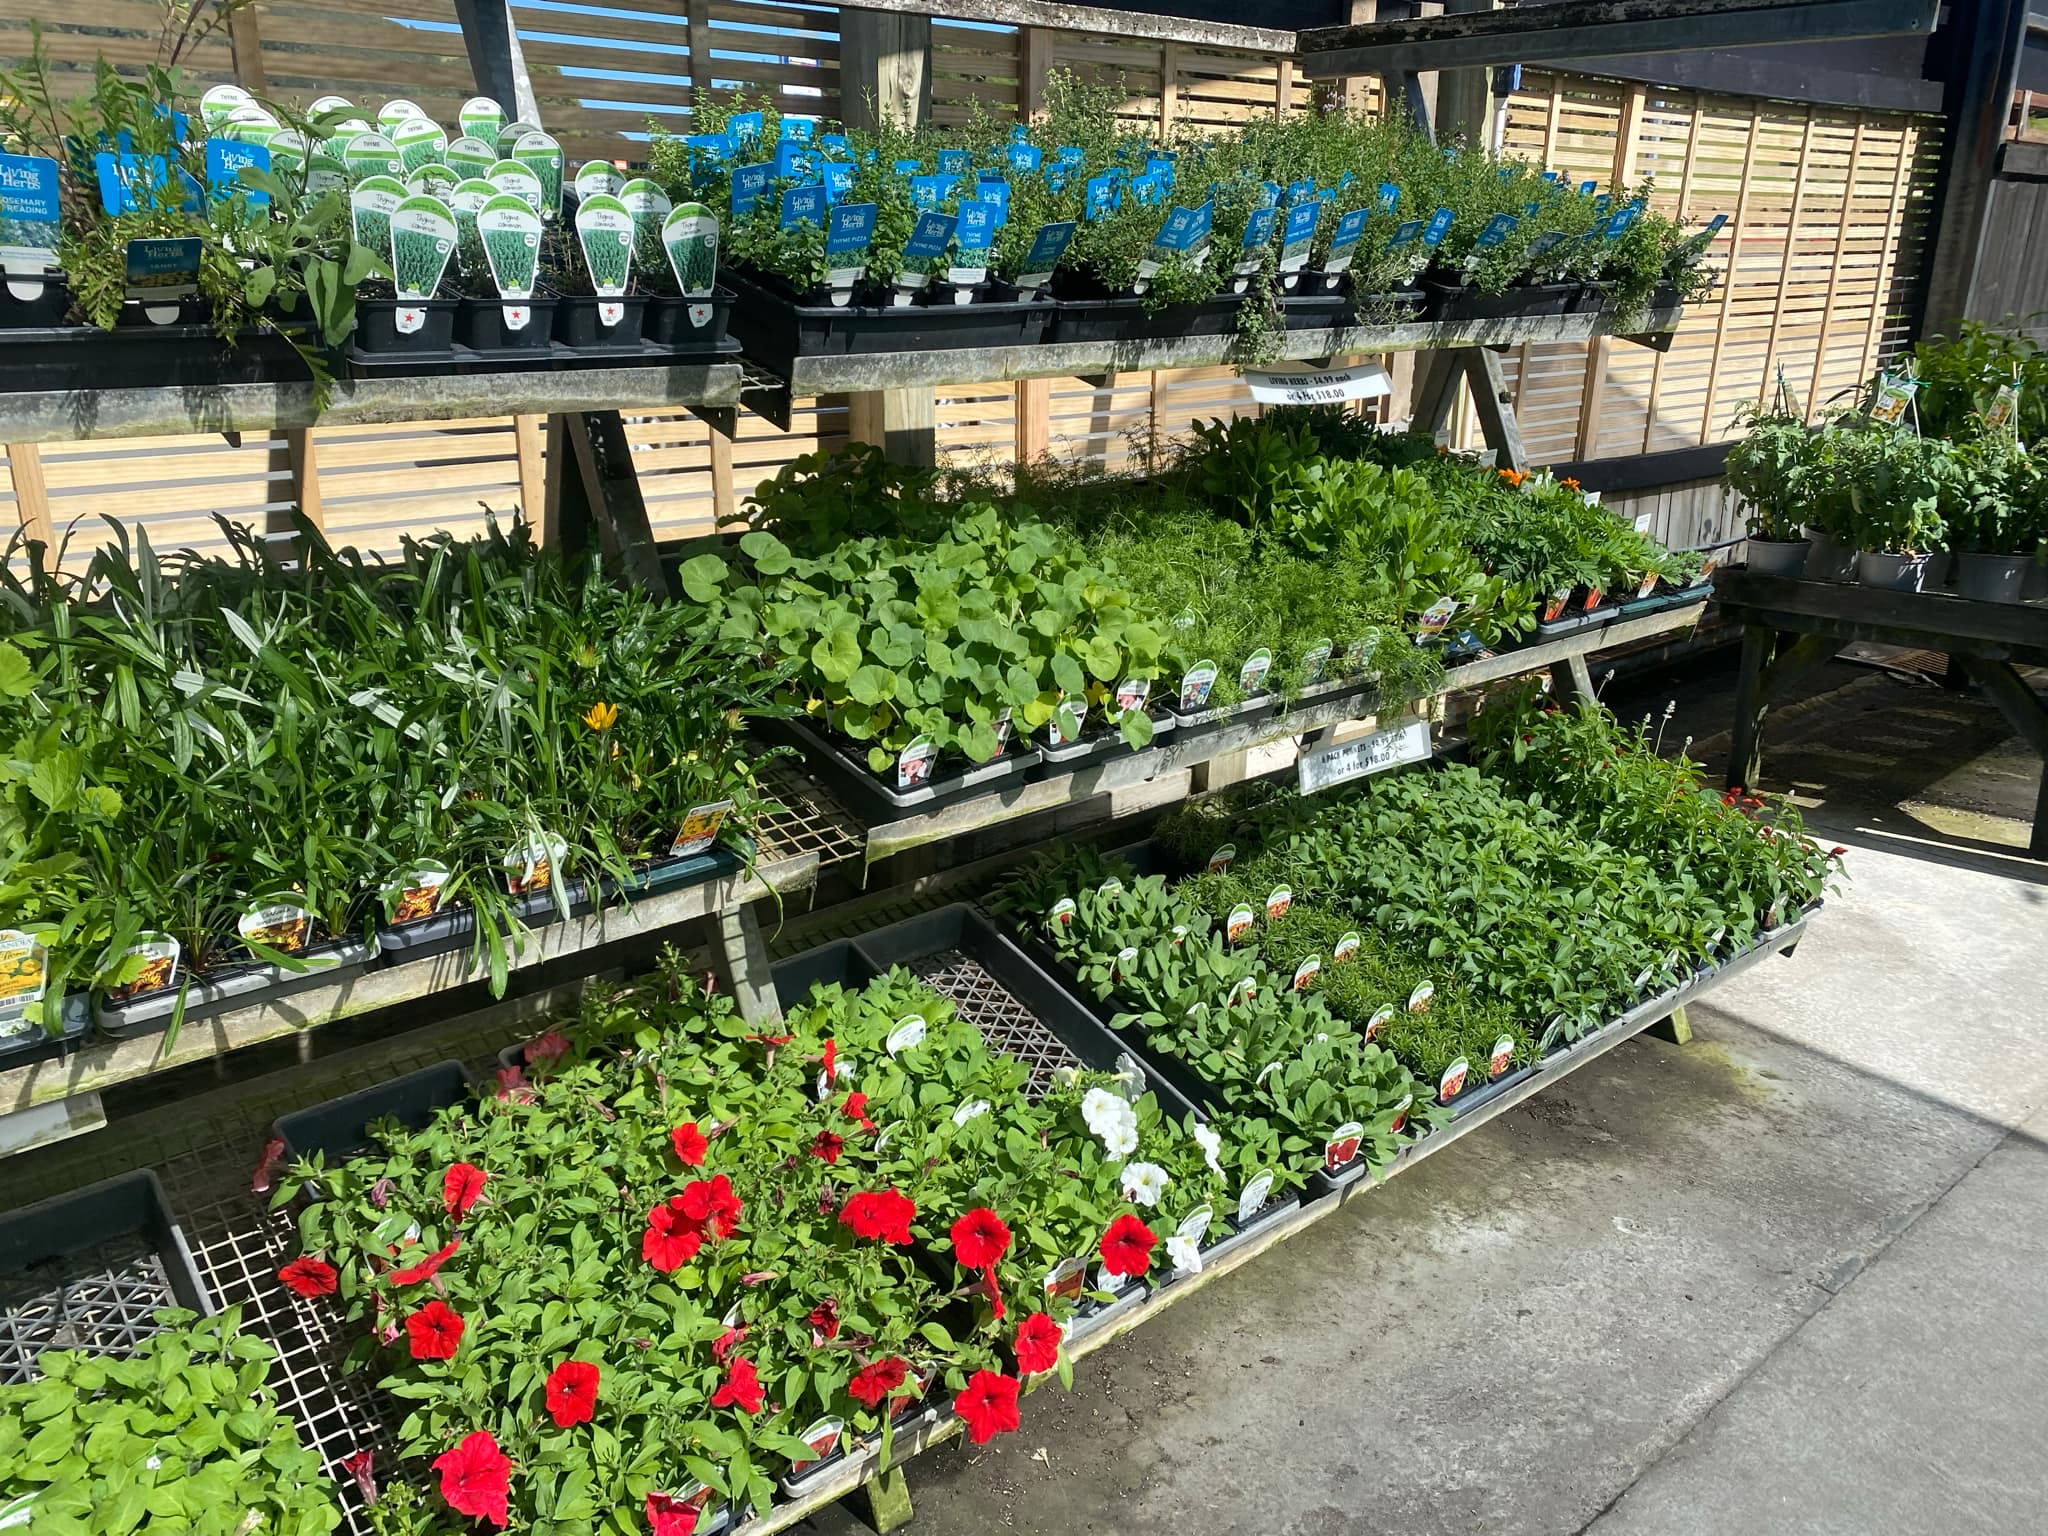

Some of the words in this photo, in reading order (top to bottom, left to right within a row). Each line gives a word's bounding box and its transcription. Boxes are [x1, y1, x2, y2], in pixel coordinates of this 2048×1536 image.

[220, 149, 254, 167] Living
[3, 172, 41, 190] Herbs
[0, 196, 47, 207] OSEMARY
[375, 194, 396, 205] Thyme
[416, 213, 436, 225] Thyme
[499, 212, 519, 223] Thyme
[596, 212, 614, 222] Thyme
[842, 214, 865, 223] Living
[411, 223, 437, 233] common
[1268, 376, 1288, 386] LIVING
[1288, 377, 1309, 386] HERBS
[1313, 376, 1334, 385] $4.99
[1335, 372, 1352, 383] each
[1315, 389, 1345, 400] $18.00
[1337, 767, 1345, 776] or
[1365, 751, 1391, 767] $18.00
